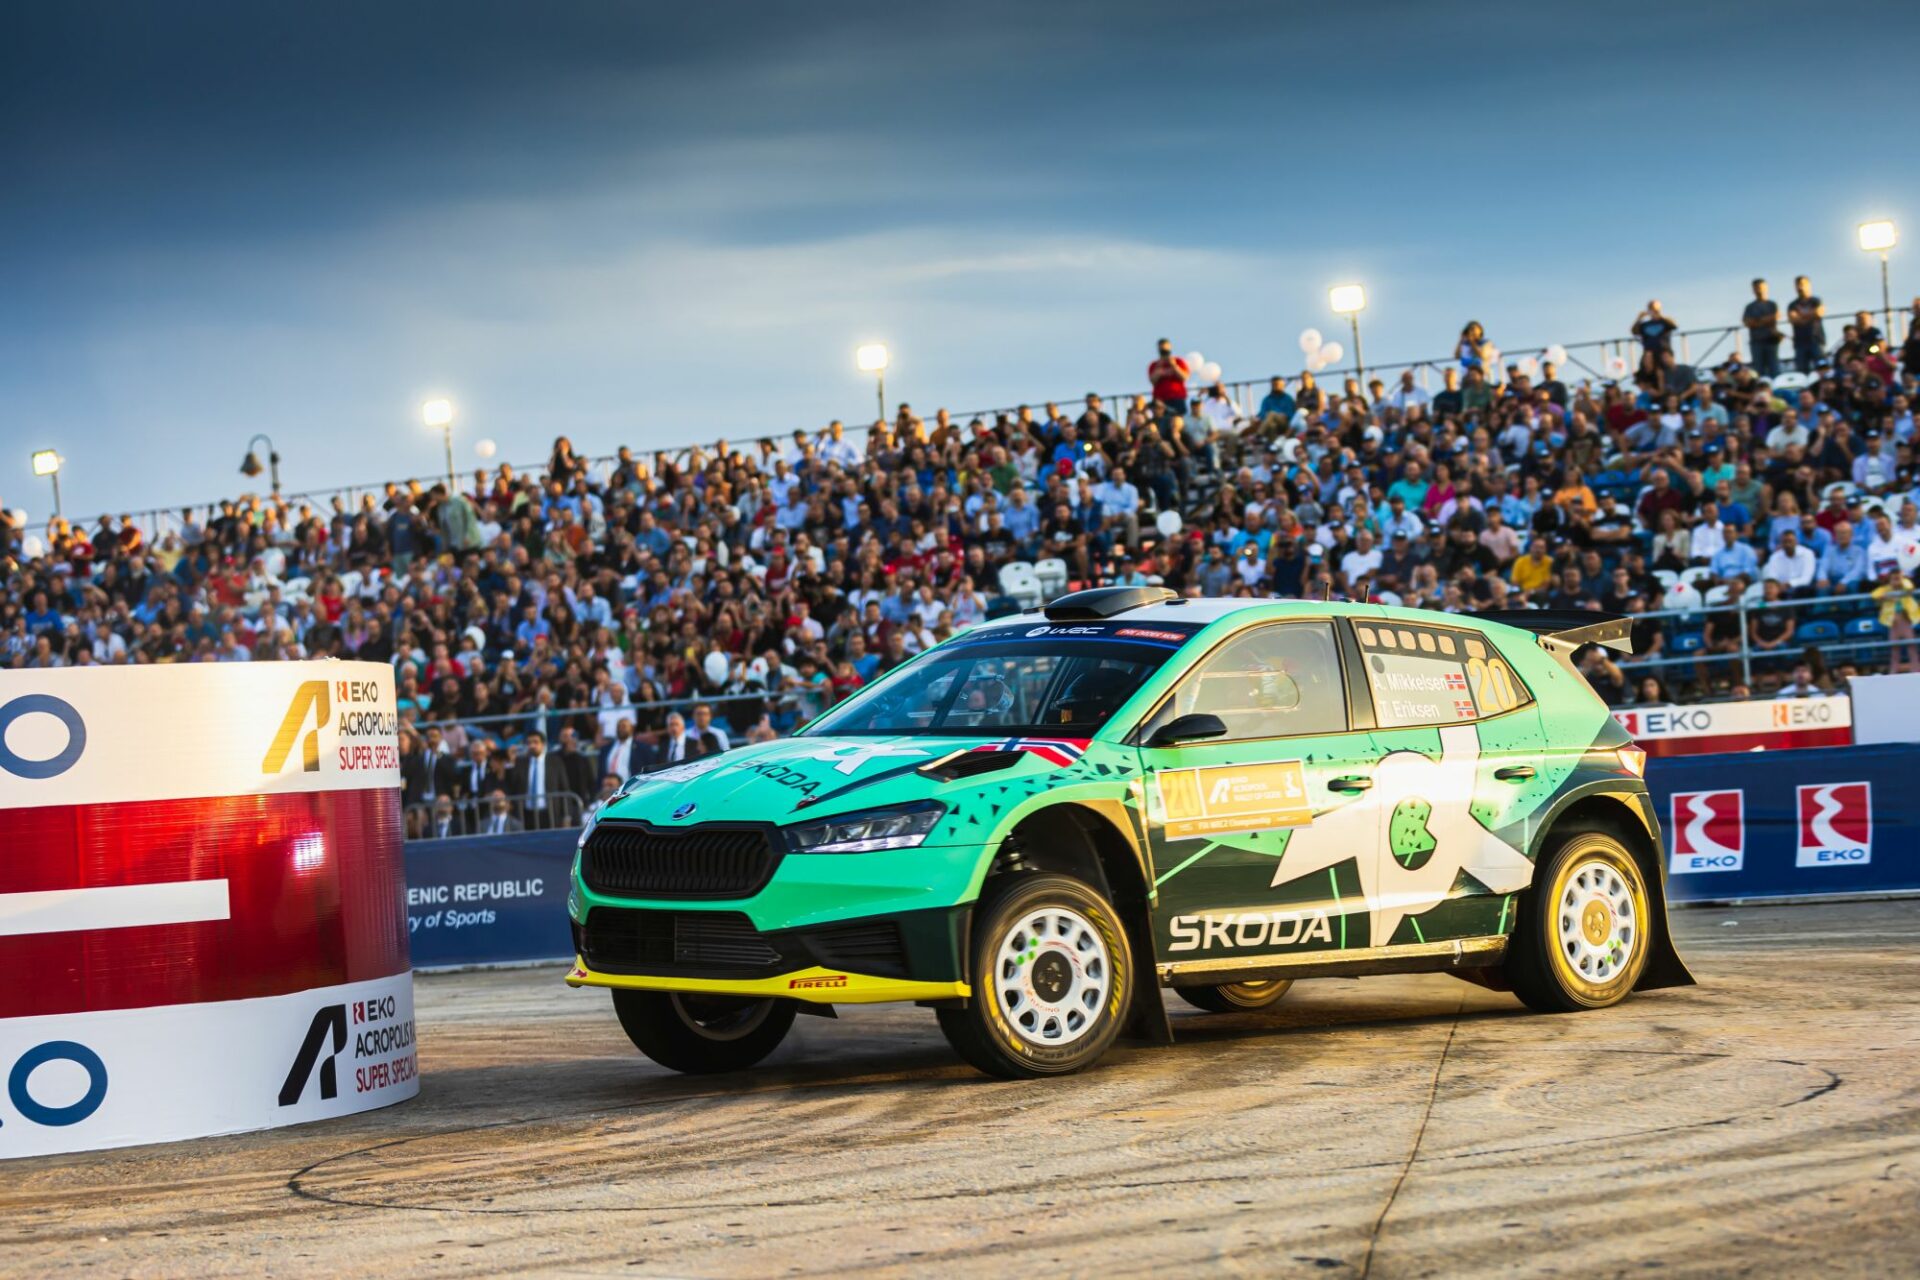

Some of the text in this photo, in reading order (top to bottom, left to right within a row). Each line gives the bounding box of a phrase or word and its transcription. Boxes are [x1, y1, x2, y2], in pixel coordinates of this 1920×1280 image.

[351, 681, 378, 703] EKO
[1386, 672, 1448, 692] Mikkelsen
[1467, 657, 1518, 712] 20
[1391, 700, 1440, 719] Eriksen
[1793, 703, 1831, 725] EKO
[1646, 710, 1711, 733] EKO
[339, 746, 373, 770] SUPER
[1162, 772, 1203, 817] 20
[1690, 855, 1738, 868] EKO
[1816, 848, 1865, 862] EKO
[453, 878, 544, 903] REPUBLIC
[425, 911, 442, 928] of
[444, 908, 496, 929] Sports
[788, 975, 848, 989] PIRELLI
[367, 996, 395, 1021] EKO
[354, 1021, 409, 1060] ACROPOLIS
[356, 1062, 391, 1094] SUPER
